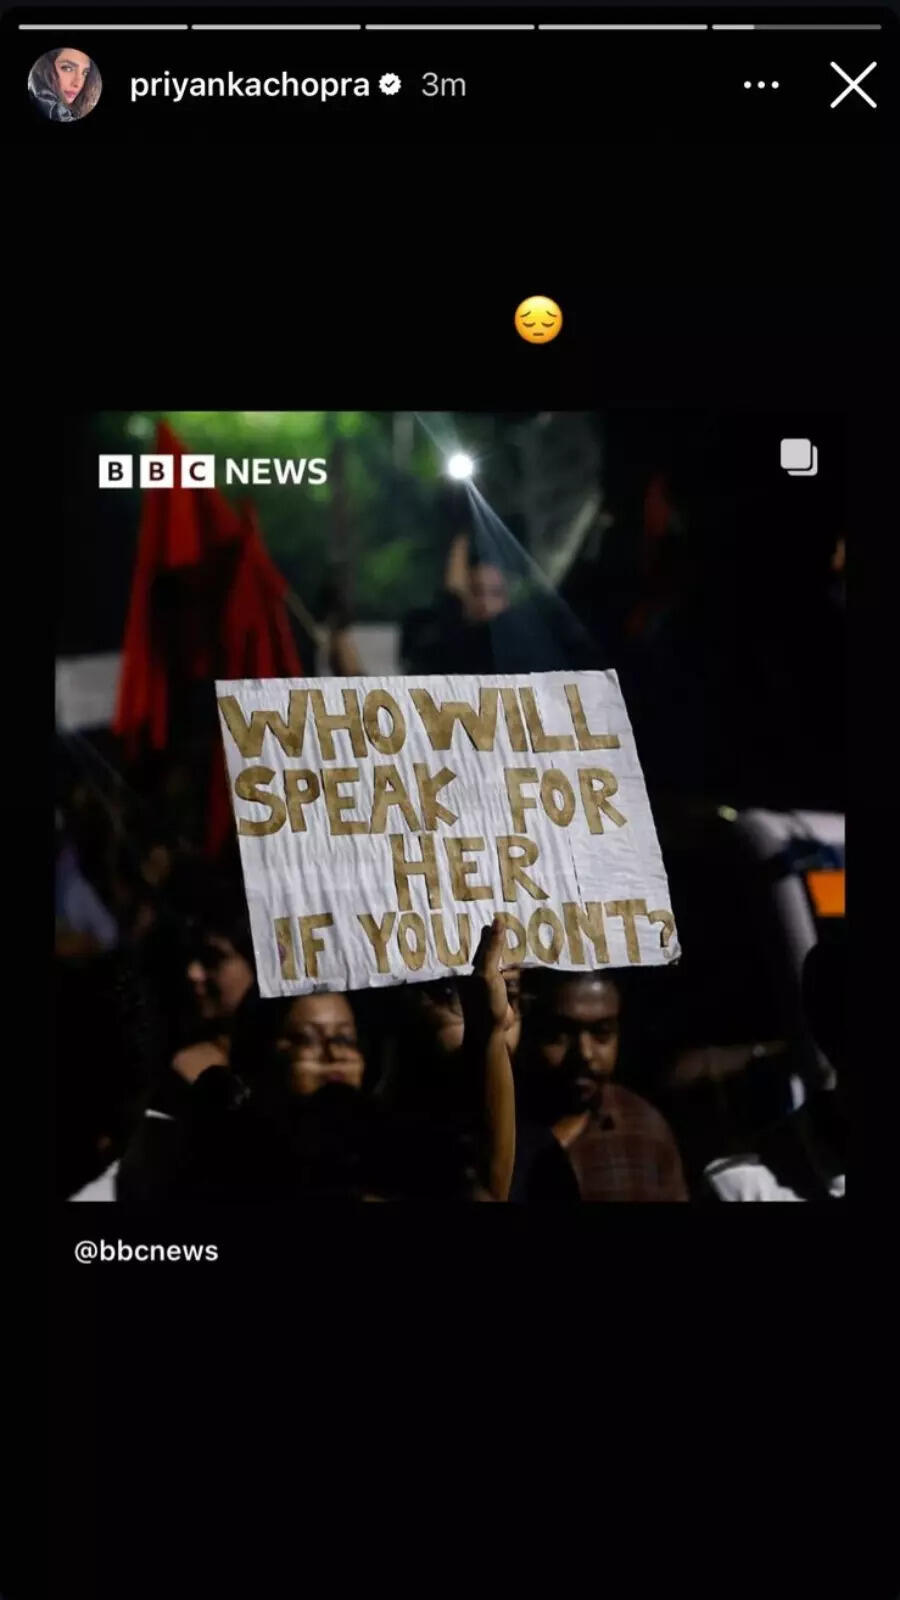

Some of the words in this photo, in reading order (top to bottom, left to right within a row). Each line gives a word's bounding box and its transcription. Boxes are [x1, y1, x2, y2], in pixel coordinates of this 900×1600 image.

[218, 689, 406, 760] WHO
[408, 684, 621, 753] WILL
[234, 763, 459, 836] SPEAK
[504, 768, 628, 834] FOR
[389, 833, 550, 911] HER
[274, 913, 333, 980] IF
[357, 911, 471, 974] YOU
